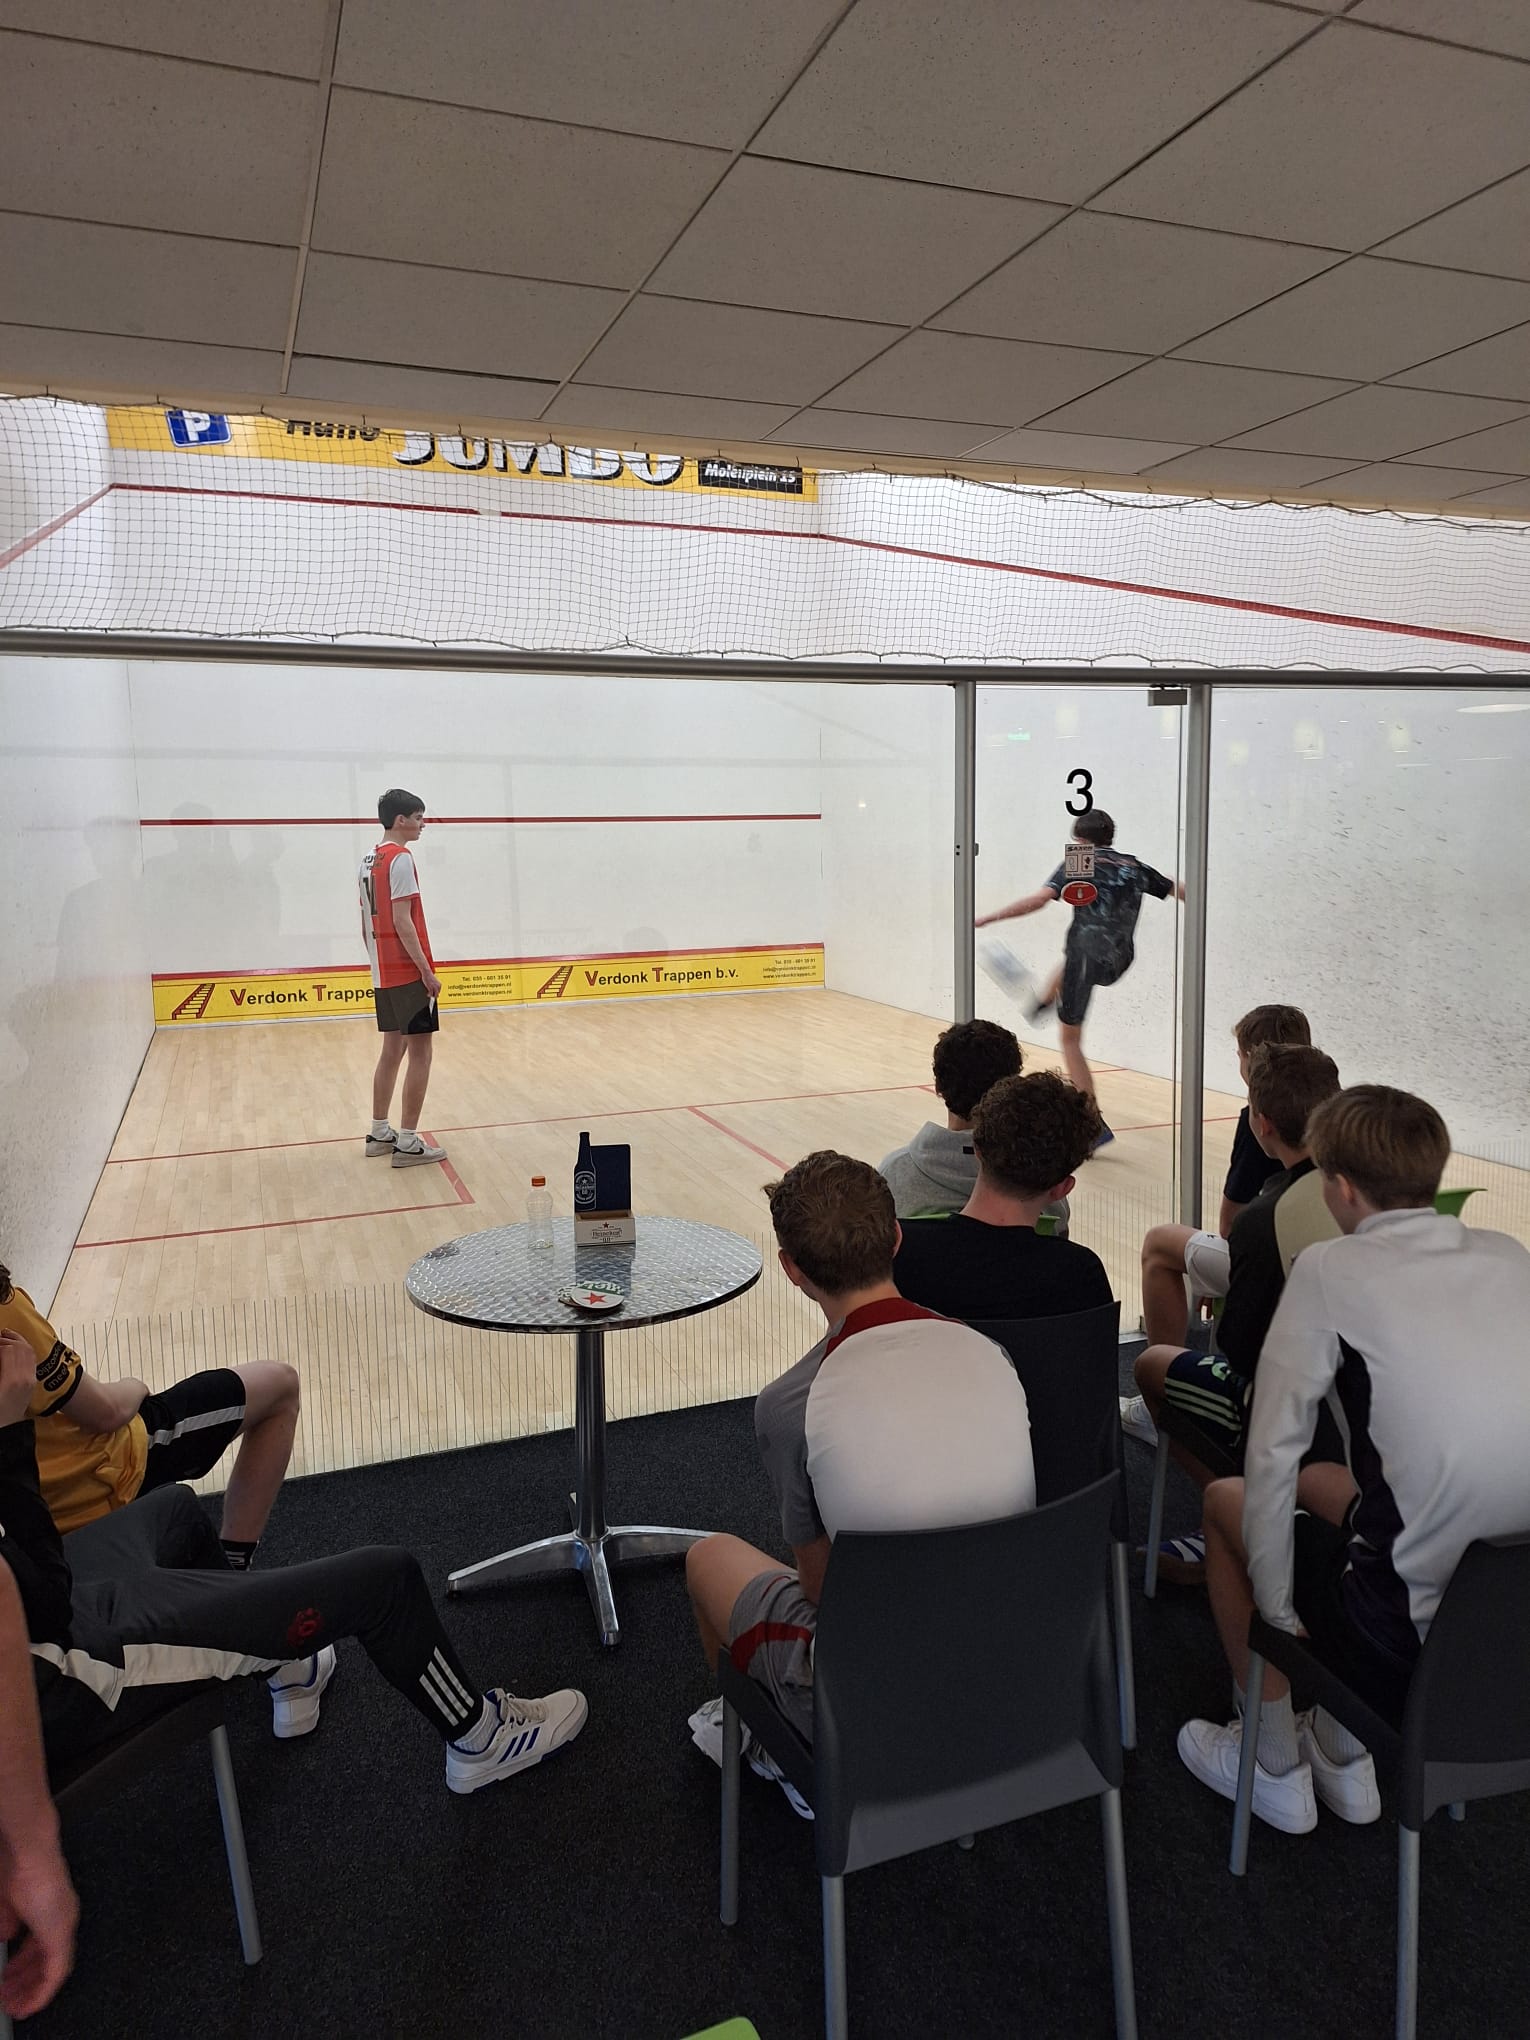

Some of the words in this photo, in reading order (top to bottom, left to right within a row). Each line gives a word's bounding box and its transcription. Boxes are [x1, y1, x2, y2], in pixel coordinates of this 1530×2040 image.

[704, 462, 777, 484] Molenplein
[1064, 768, 1094, 817] 3
[584, 970, 649, 987] Verdonk
[652, 967, 711, 984] Trappen
[716, 966, 739, 979] b.v.
[230, 988, 309, 1006] Verdonk
[312, 984, 375, 1002] Trappe
